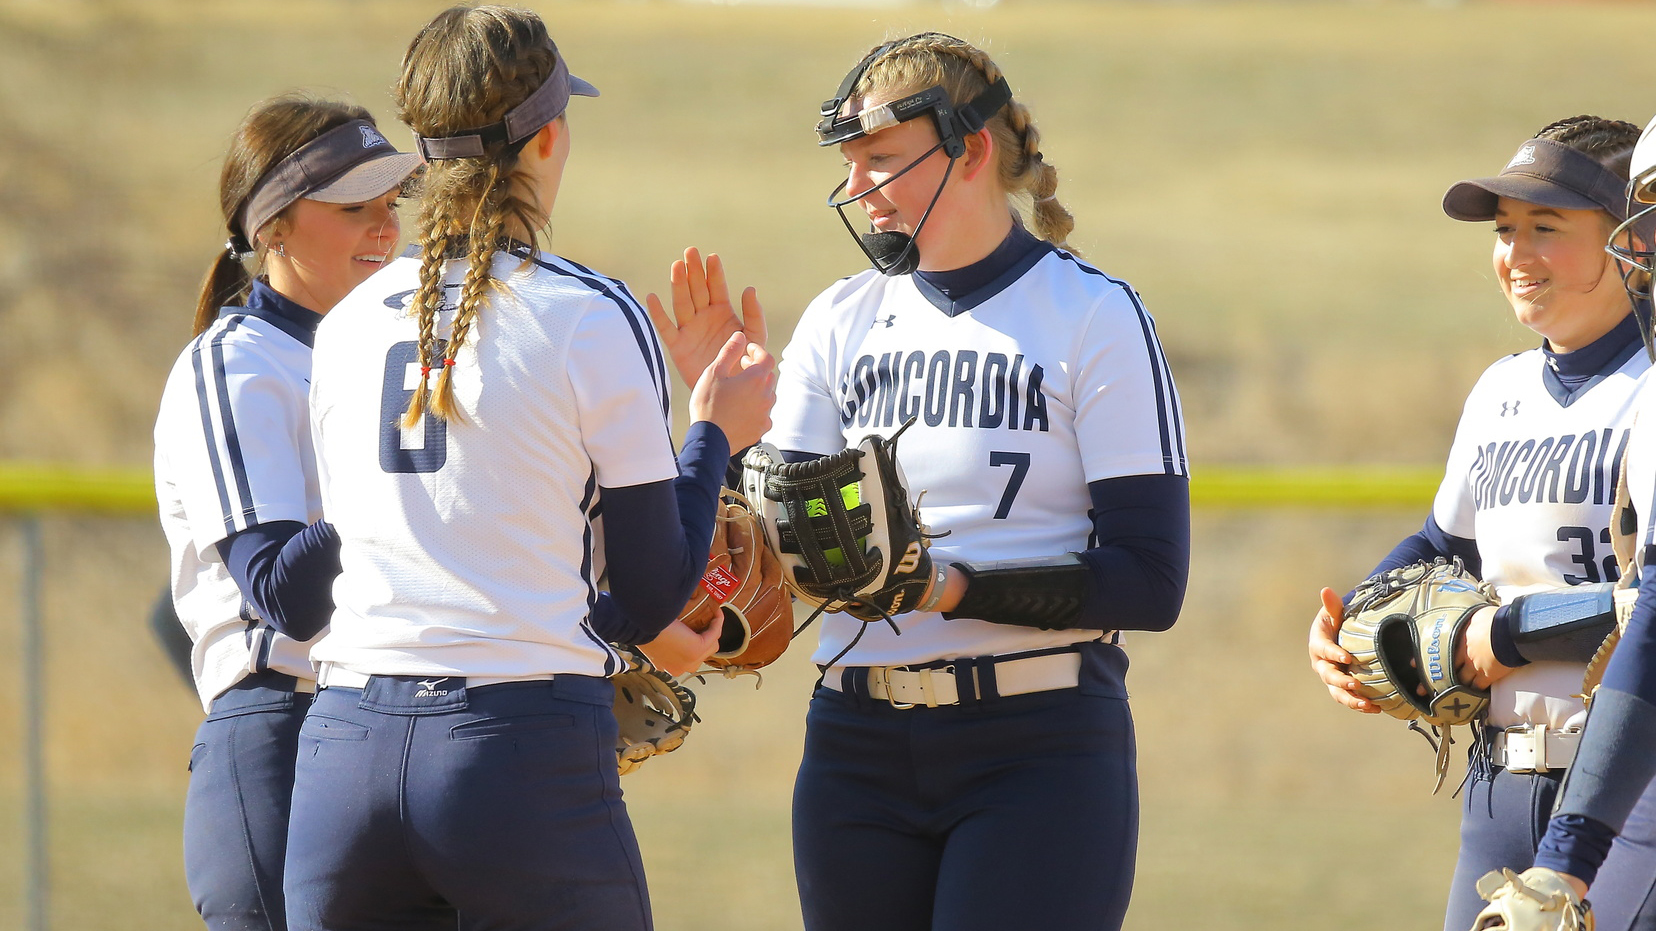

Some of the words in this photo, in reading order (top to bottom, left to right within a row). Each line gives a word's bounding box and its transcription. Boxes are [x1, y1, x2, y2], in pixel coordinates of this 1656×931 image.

[379, 338, 448, 473] 6
[840, 349, 1049, 432] CONCORDIA
[989, 451, 1031, 520] 7
[1430, 615, 1446, 683] Wilson
[414, 689, 448, 698] MIZUNO
